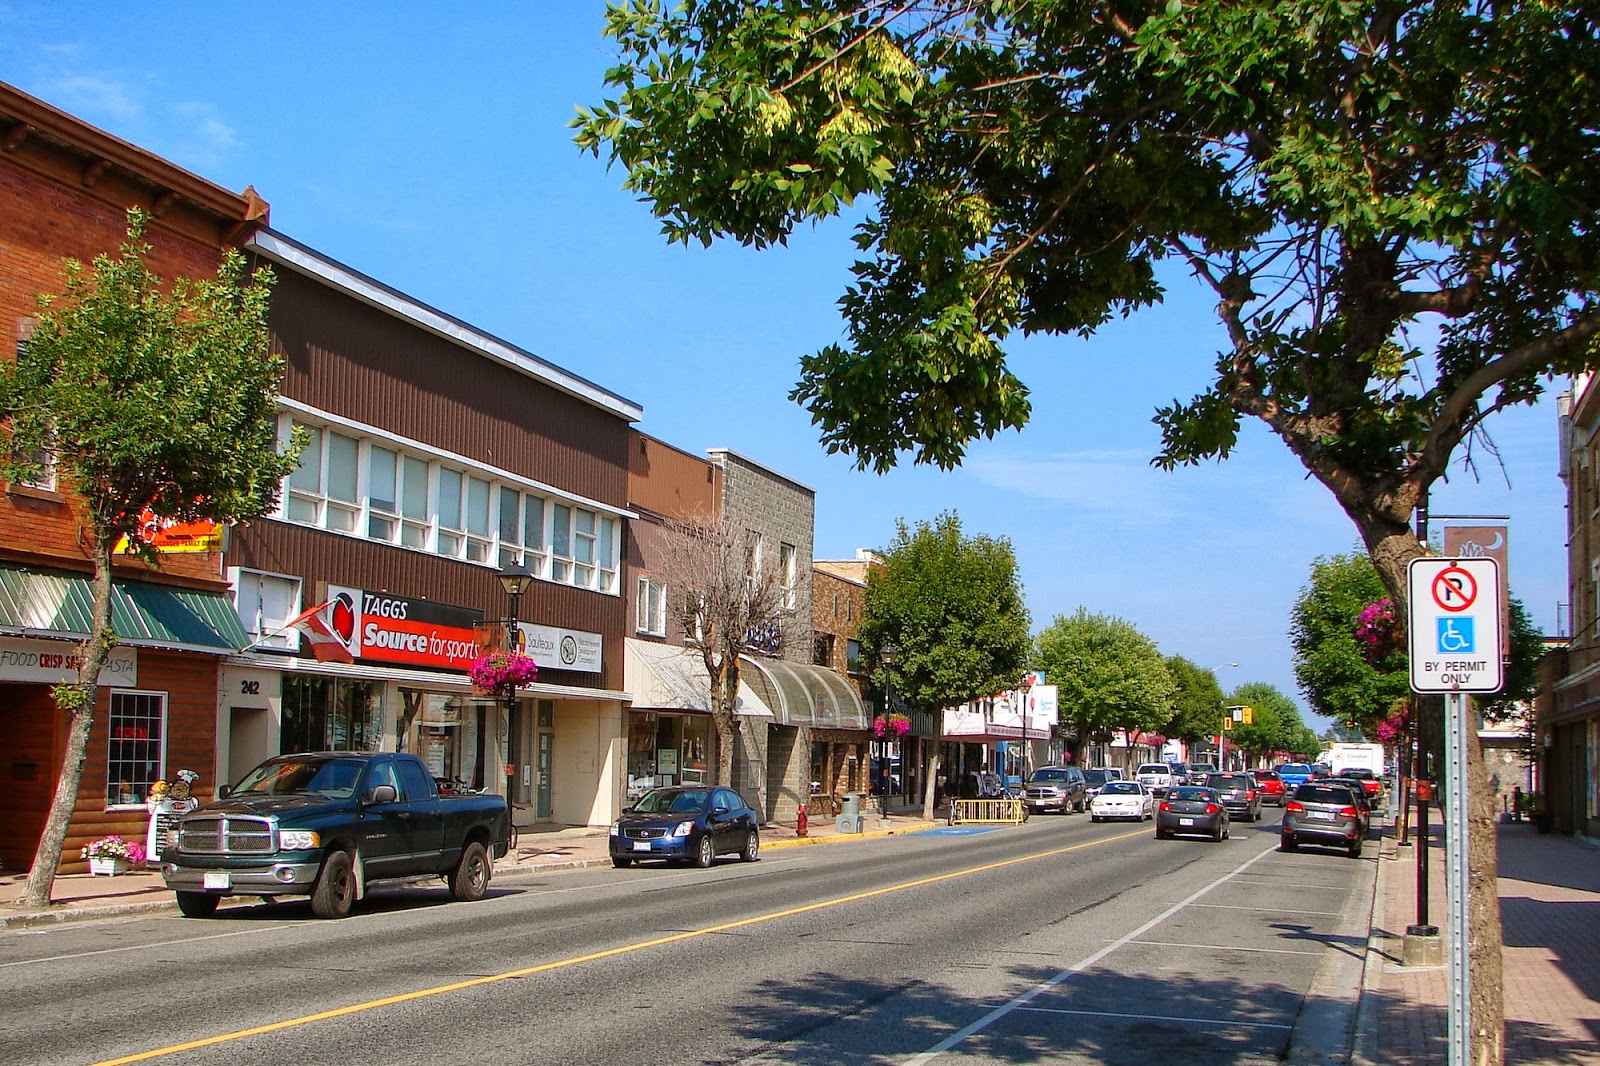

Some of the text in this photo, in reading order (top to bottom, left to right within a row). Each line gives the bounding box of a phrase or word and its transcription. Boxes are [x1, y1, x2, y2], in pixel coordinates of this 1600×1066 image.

[363, 594, 408, 620] TAGGS
[363, 623, 480, 663] Source for sports
[0, 650, 38, 667] FOOD
[40, 653, 63, 669] CRISP
[101, 656, 134, 673] PASTA
[1425, 662, 1487, 672] BY PERMIT
[1441, 674, 1472, 683] ONLY
[241, 680, 260, 695] 242
[115, 726, 147, 743] OPEN
